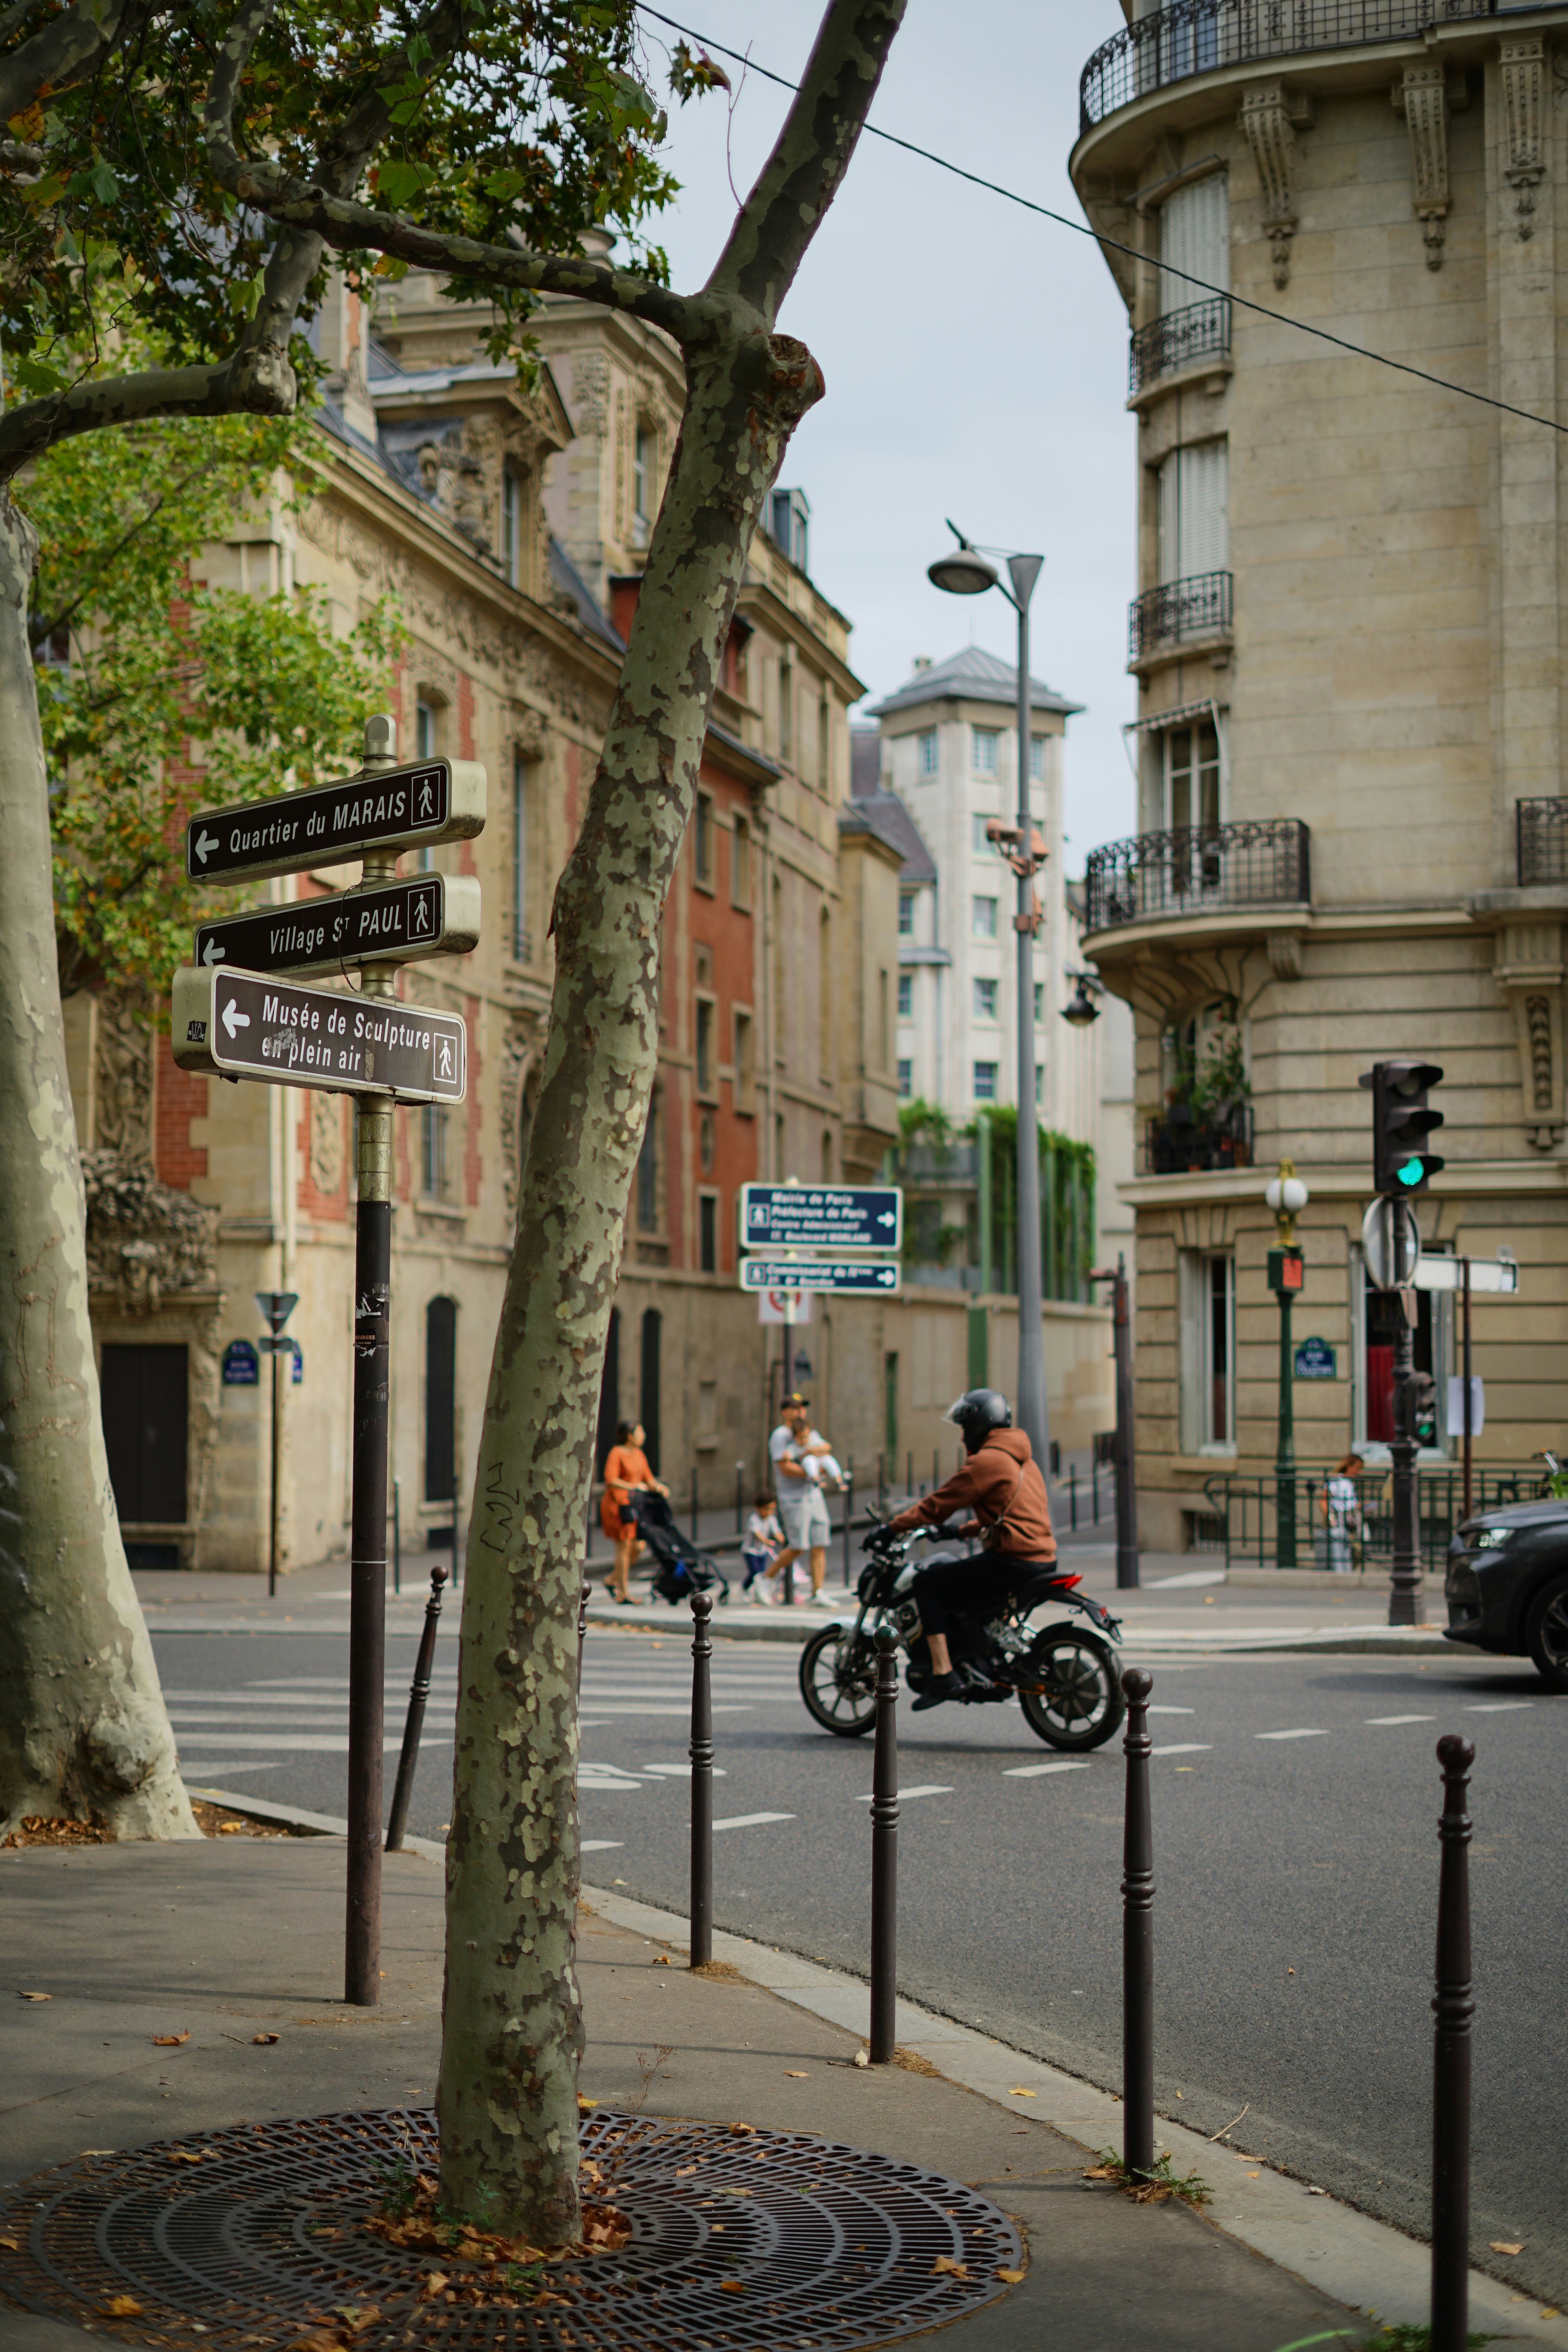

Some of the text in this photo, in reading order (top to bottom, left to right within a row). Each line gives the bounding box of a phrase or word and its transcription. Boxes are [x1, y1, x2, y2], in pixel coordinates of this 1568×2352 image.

[230, 791, 406, 853] Quartier du MARAIS
[270, 925, 324, 955] Village
[359, 905, 403, 937] PAUL
[262, 995, 430, 1050] Musée de Sculpture
[262, 1036, 361, 1071] en plein air
[771, 1192, 853, 1206] Mairie de Paris
[826, 1207, 840, 1219] de
[841, 1207, 868, 1220] Paris
[833, 1267, 846, 1278] du
